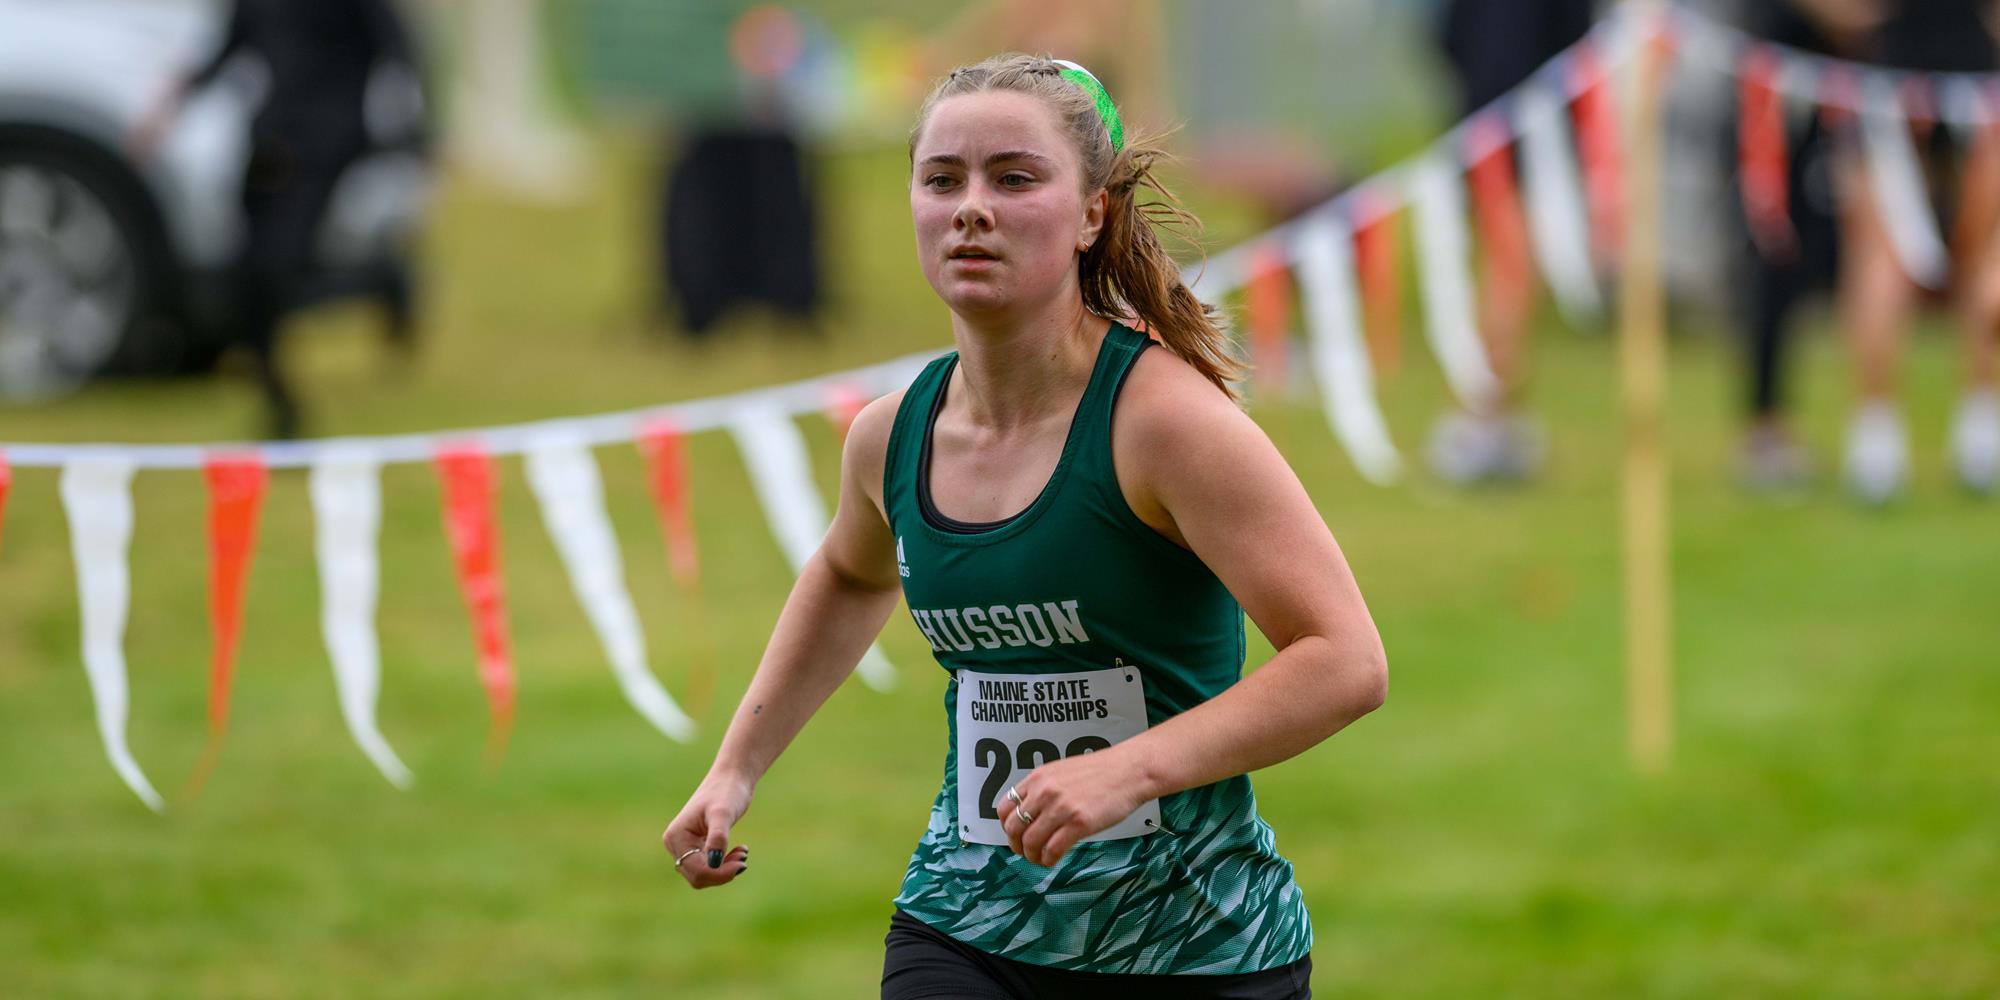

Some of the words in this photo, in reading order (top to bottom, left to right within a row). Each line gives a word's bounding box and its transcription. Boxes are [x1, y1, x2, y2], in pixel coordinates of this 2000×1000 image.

[911, 600, 1090, 652] HUSSON
[978, 680, 1029, 702] MAINE
[1033, 679, 1091, 701] STATE
[971, 699, 1109, 724] CHAMPIONSHIPS
